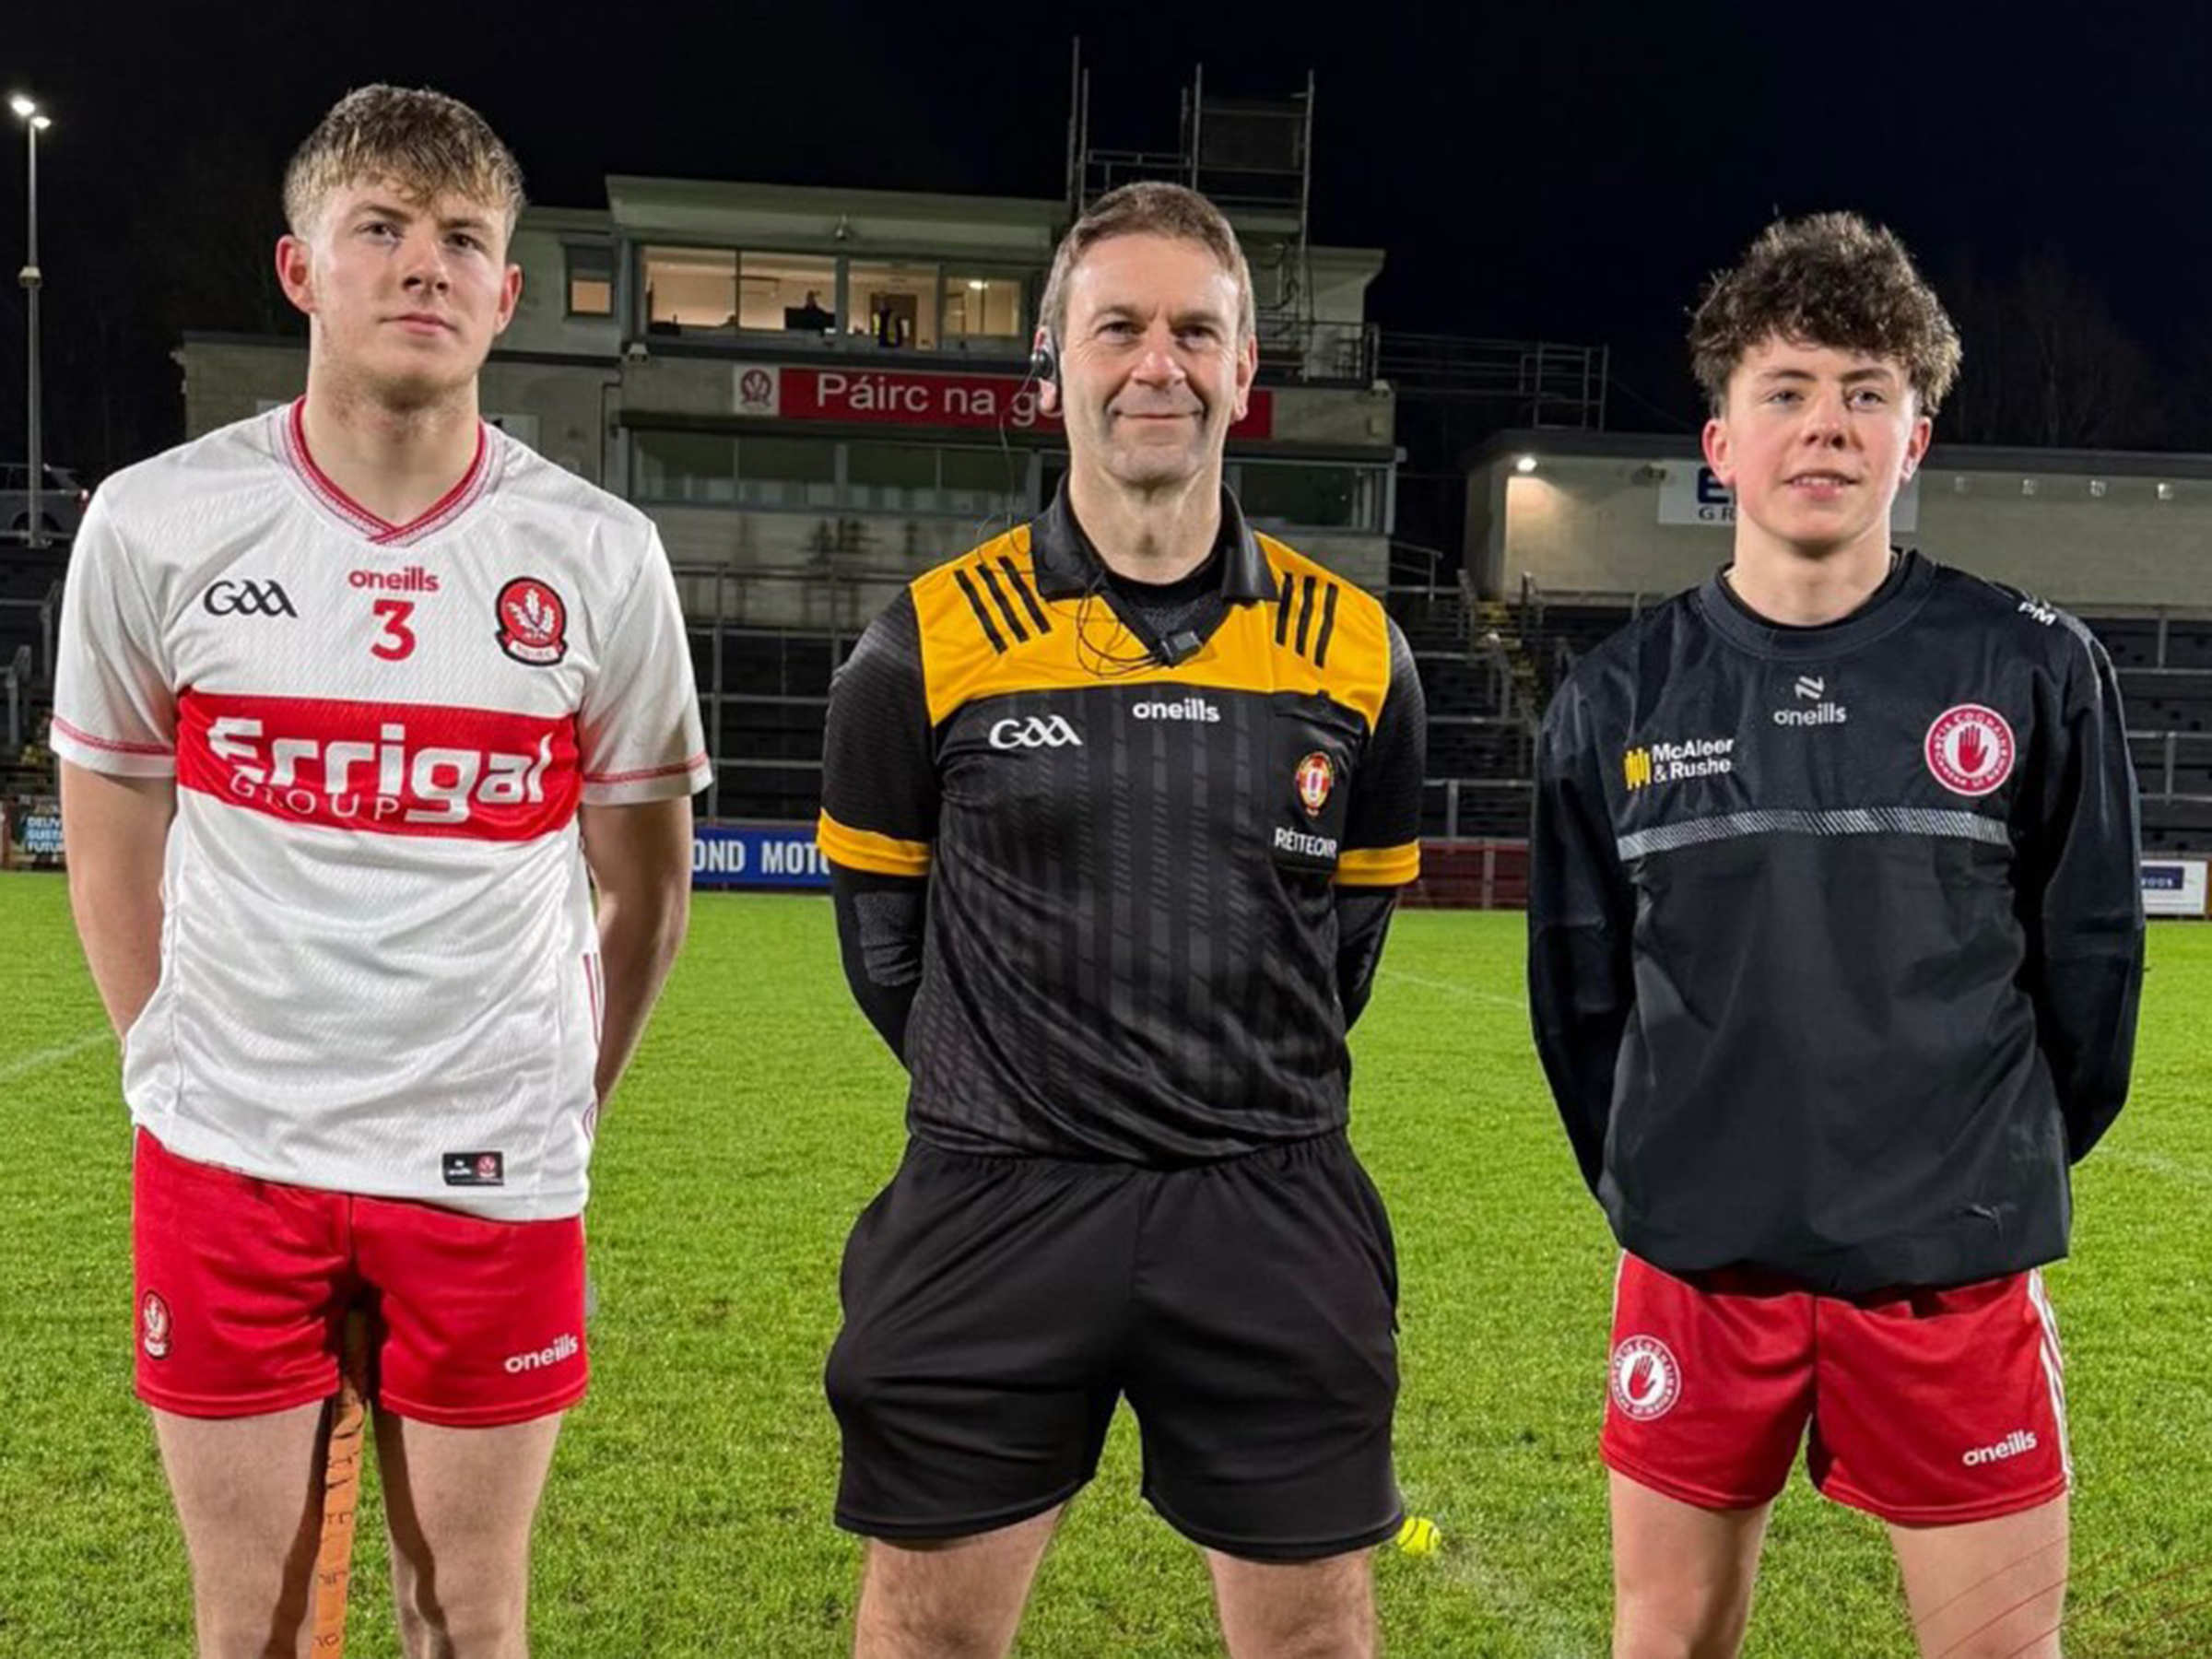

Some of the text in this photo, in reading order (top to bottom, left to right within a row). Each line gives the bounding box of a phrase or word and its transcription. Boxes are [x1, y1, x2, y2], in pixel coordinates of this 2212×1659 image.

[818, 372, 928, 412] Páirc
[943, 386, 995, 414] na
[203, 579, 298, 618] GAA
[2017, 600, 2057, 627] PM
[370, 599, 417, 662] 3
[988, 713, 1084, 750] GAA
[1652, 738, 1735, 764] McAleer
[1653, 758, 1732, 783] & Rushe
[761, 841, 830, 875] MOT
